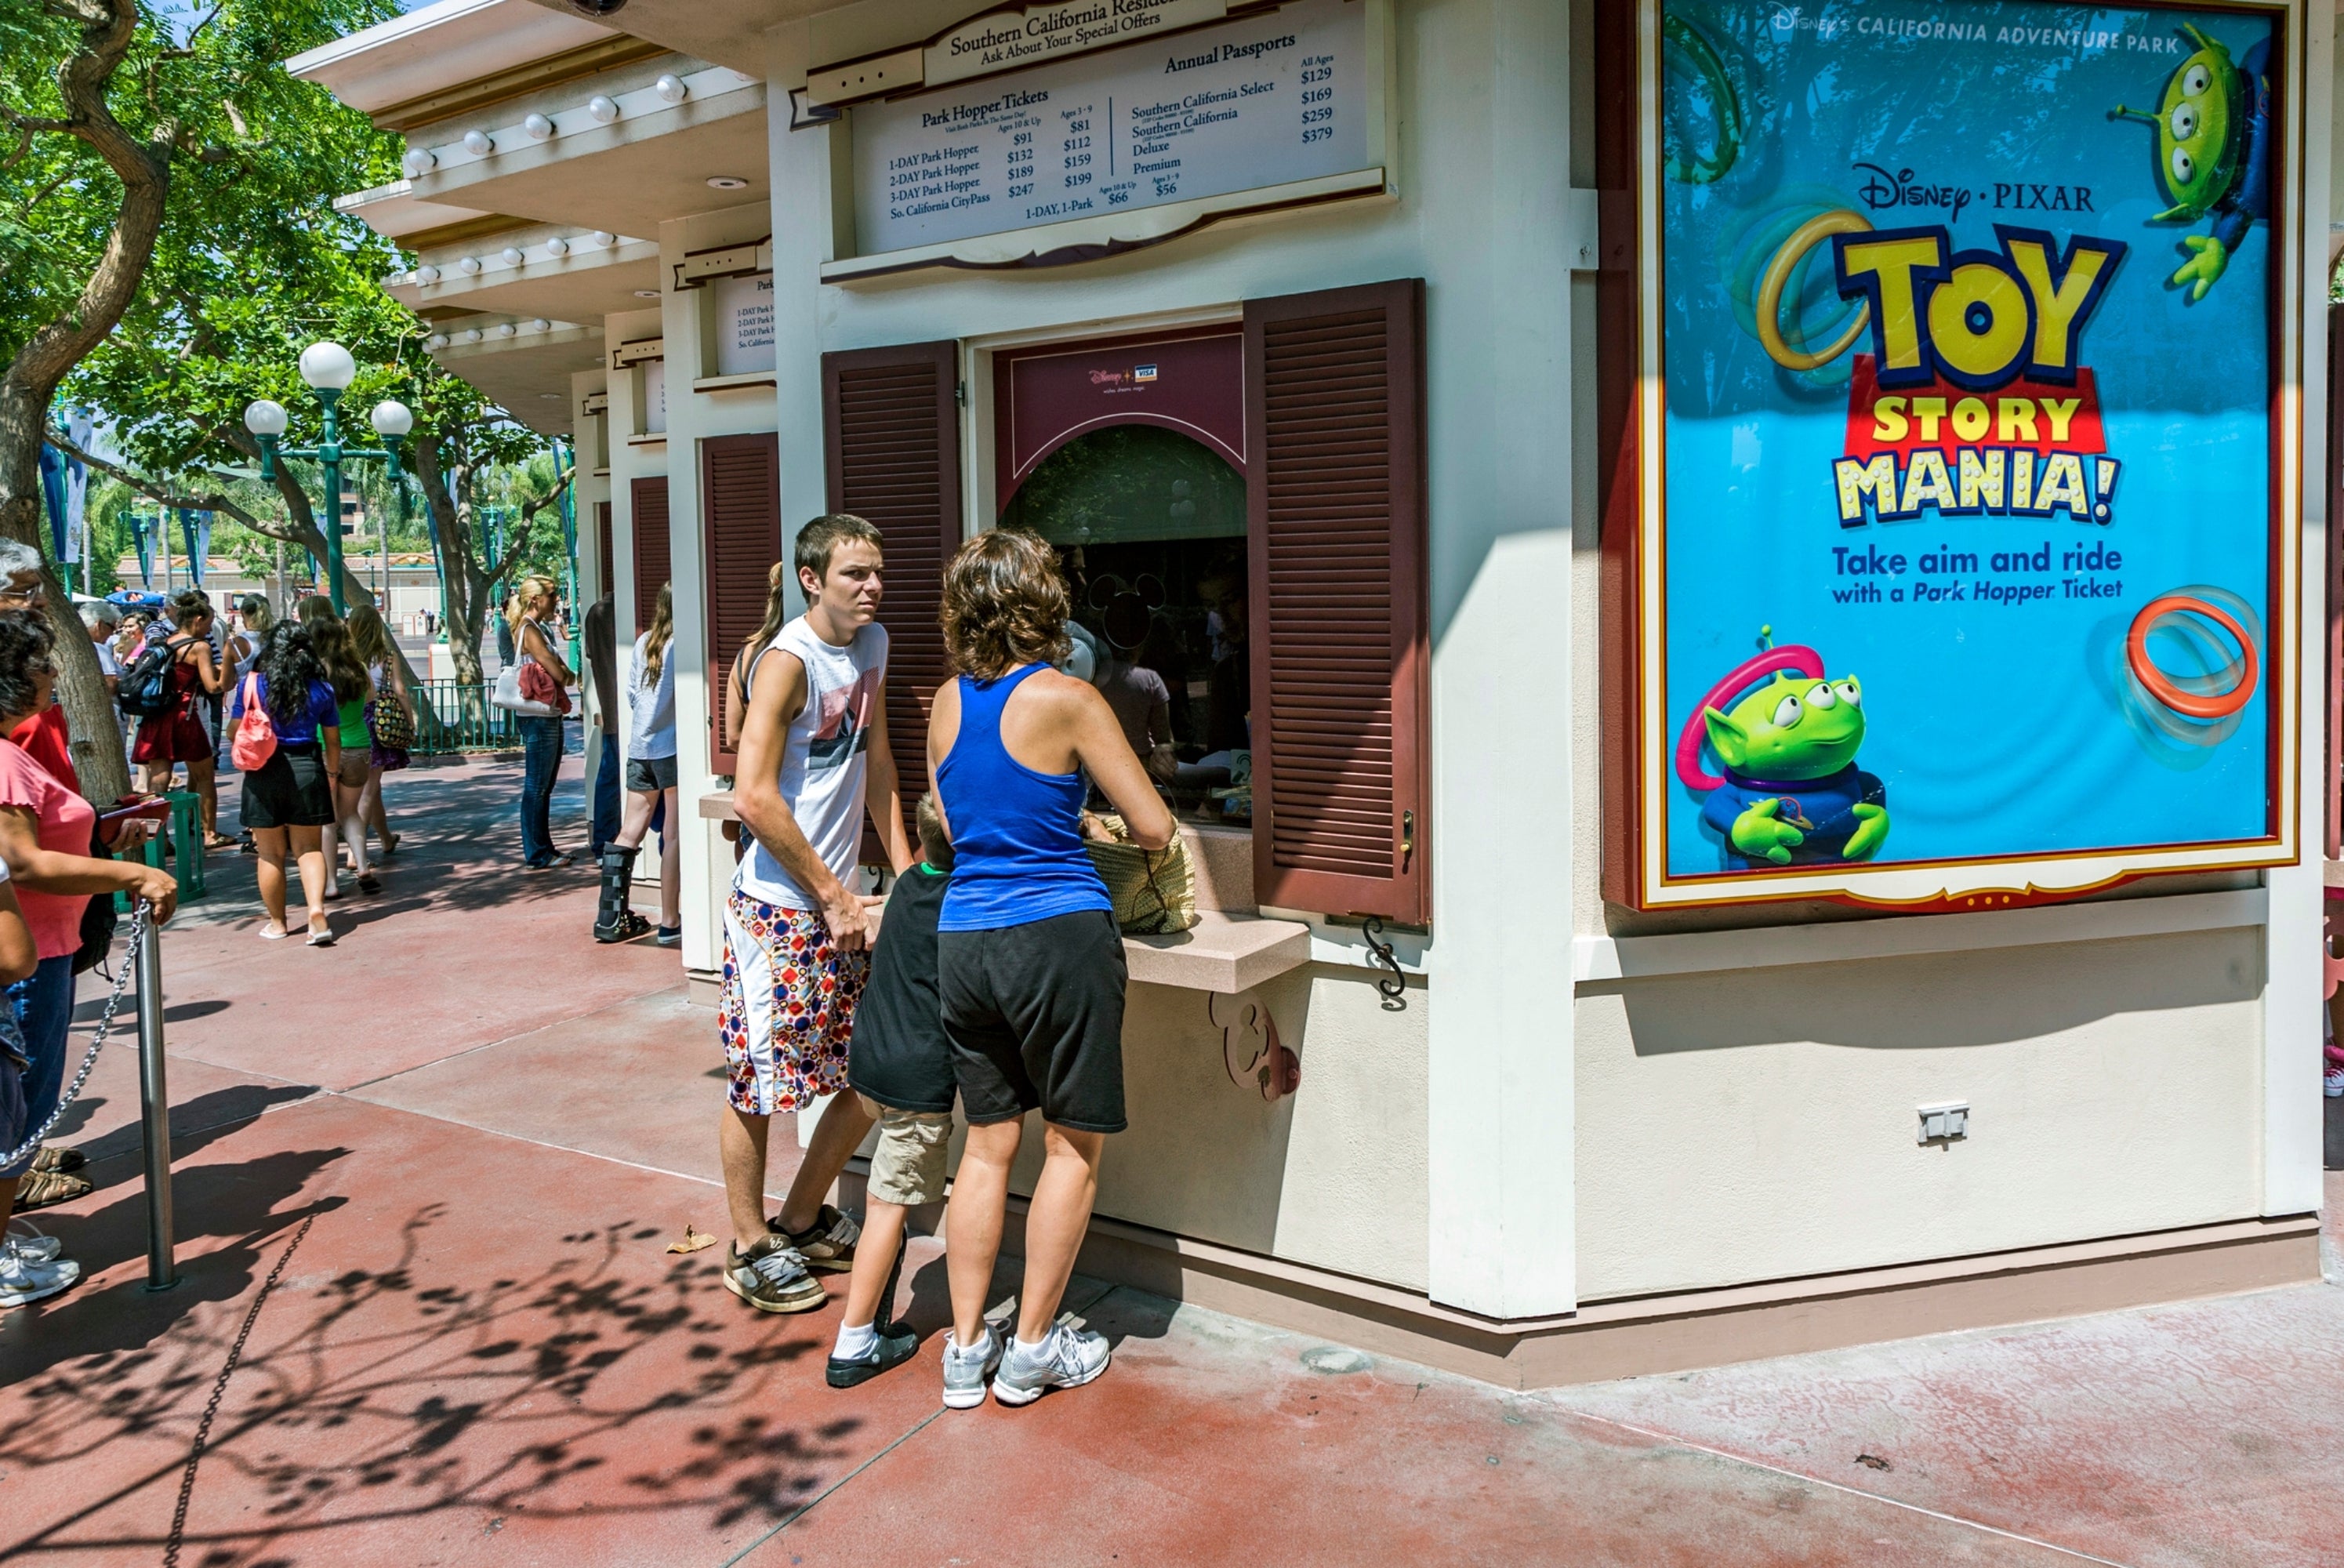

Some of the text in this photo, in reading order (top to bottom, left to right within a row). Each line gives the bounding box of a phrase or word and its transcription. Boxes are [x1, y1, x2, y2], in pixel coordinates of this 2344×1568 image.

[950, 27, 1022, 56] Southern
[1025, 3, 1107, 37] California
[981, 12, 1160, 65] Ask About Your Special Offers
[1857, 16, 1988, 42] CALIFORNIA
[1996, 27, 2119, 49] ADVENTURE
[2127, 34, 2179, 54] PARK
[1165, 34, 1296, 74] Annual Passports
[1301, 53, 1333, 67] All Ages
[922, 108, 950, 128] Park
[1001, 89, 1049, 110] Tickets
[1060, 111, 1076, 120] Ages
[1132, 103, 1181, 119] Southern
[1183, 88, 1238, 108] California
[1240, 81, 1275, 97] Select
[1301, 67, 1332, 85] $129
[1132, 122, 1181, 138] Southern
[1183, 107, 1238, 128] California
[1301, 87, 1332, 105] $169
[889, 154, 920, 170] 1-DAY
[921, 150, 942, 164] Park
[1014, 132, 1033, 147] $91
[1070, 119, 1090, 134] $81
[997, 123, 1013, 133] Ages
[1031, 116, 1041, 126] Up
[1133, 107, 1333, 157] Deluxe $259
[890, 170, 920, 187] 2-DAY
[922, 166, 942, 180] Park
[1007, 148, 1033, 164] $132
[1064, 136, 1091, 152] $112
[1134, 126, 1333, 175] Premium $379
[890, 187, 920, 203] 3-DAY
[923, 183, 942, 197] Park
[1007, 165, 1034, 181] $189
[1065, 153, 1091, 169] $159
[891, 172, 1092, 220] So. California CityPass $247 $199
[1025, 182, 1177, 220] 1-DAY, 1-Park $66 $56
[1852, 162, 2095, 223] Disney PIXAR
[757, 305, 769, 314] Park
[757, 316, 770, 325] Park
[1832, 223, 2127, 390] TOY
[757, 326, 771, 335] Park
[1089, 369, 1122, 385] Disney
[1872, 396, 2082, 443] STORY
[1832, 446, 2121, 528] MANIA!
[1831, 540, 2122, 575] Take aim and ride
[1832, 576, 2123, 606] with a Park Hopper Ticket
